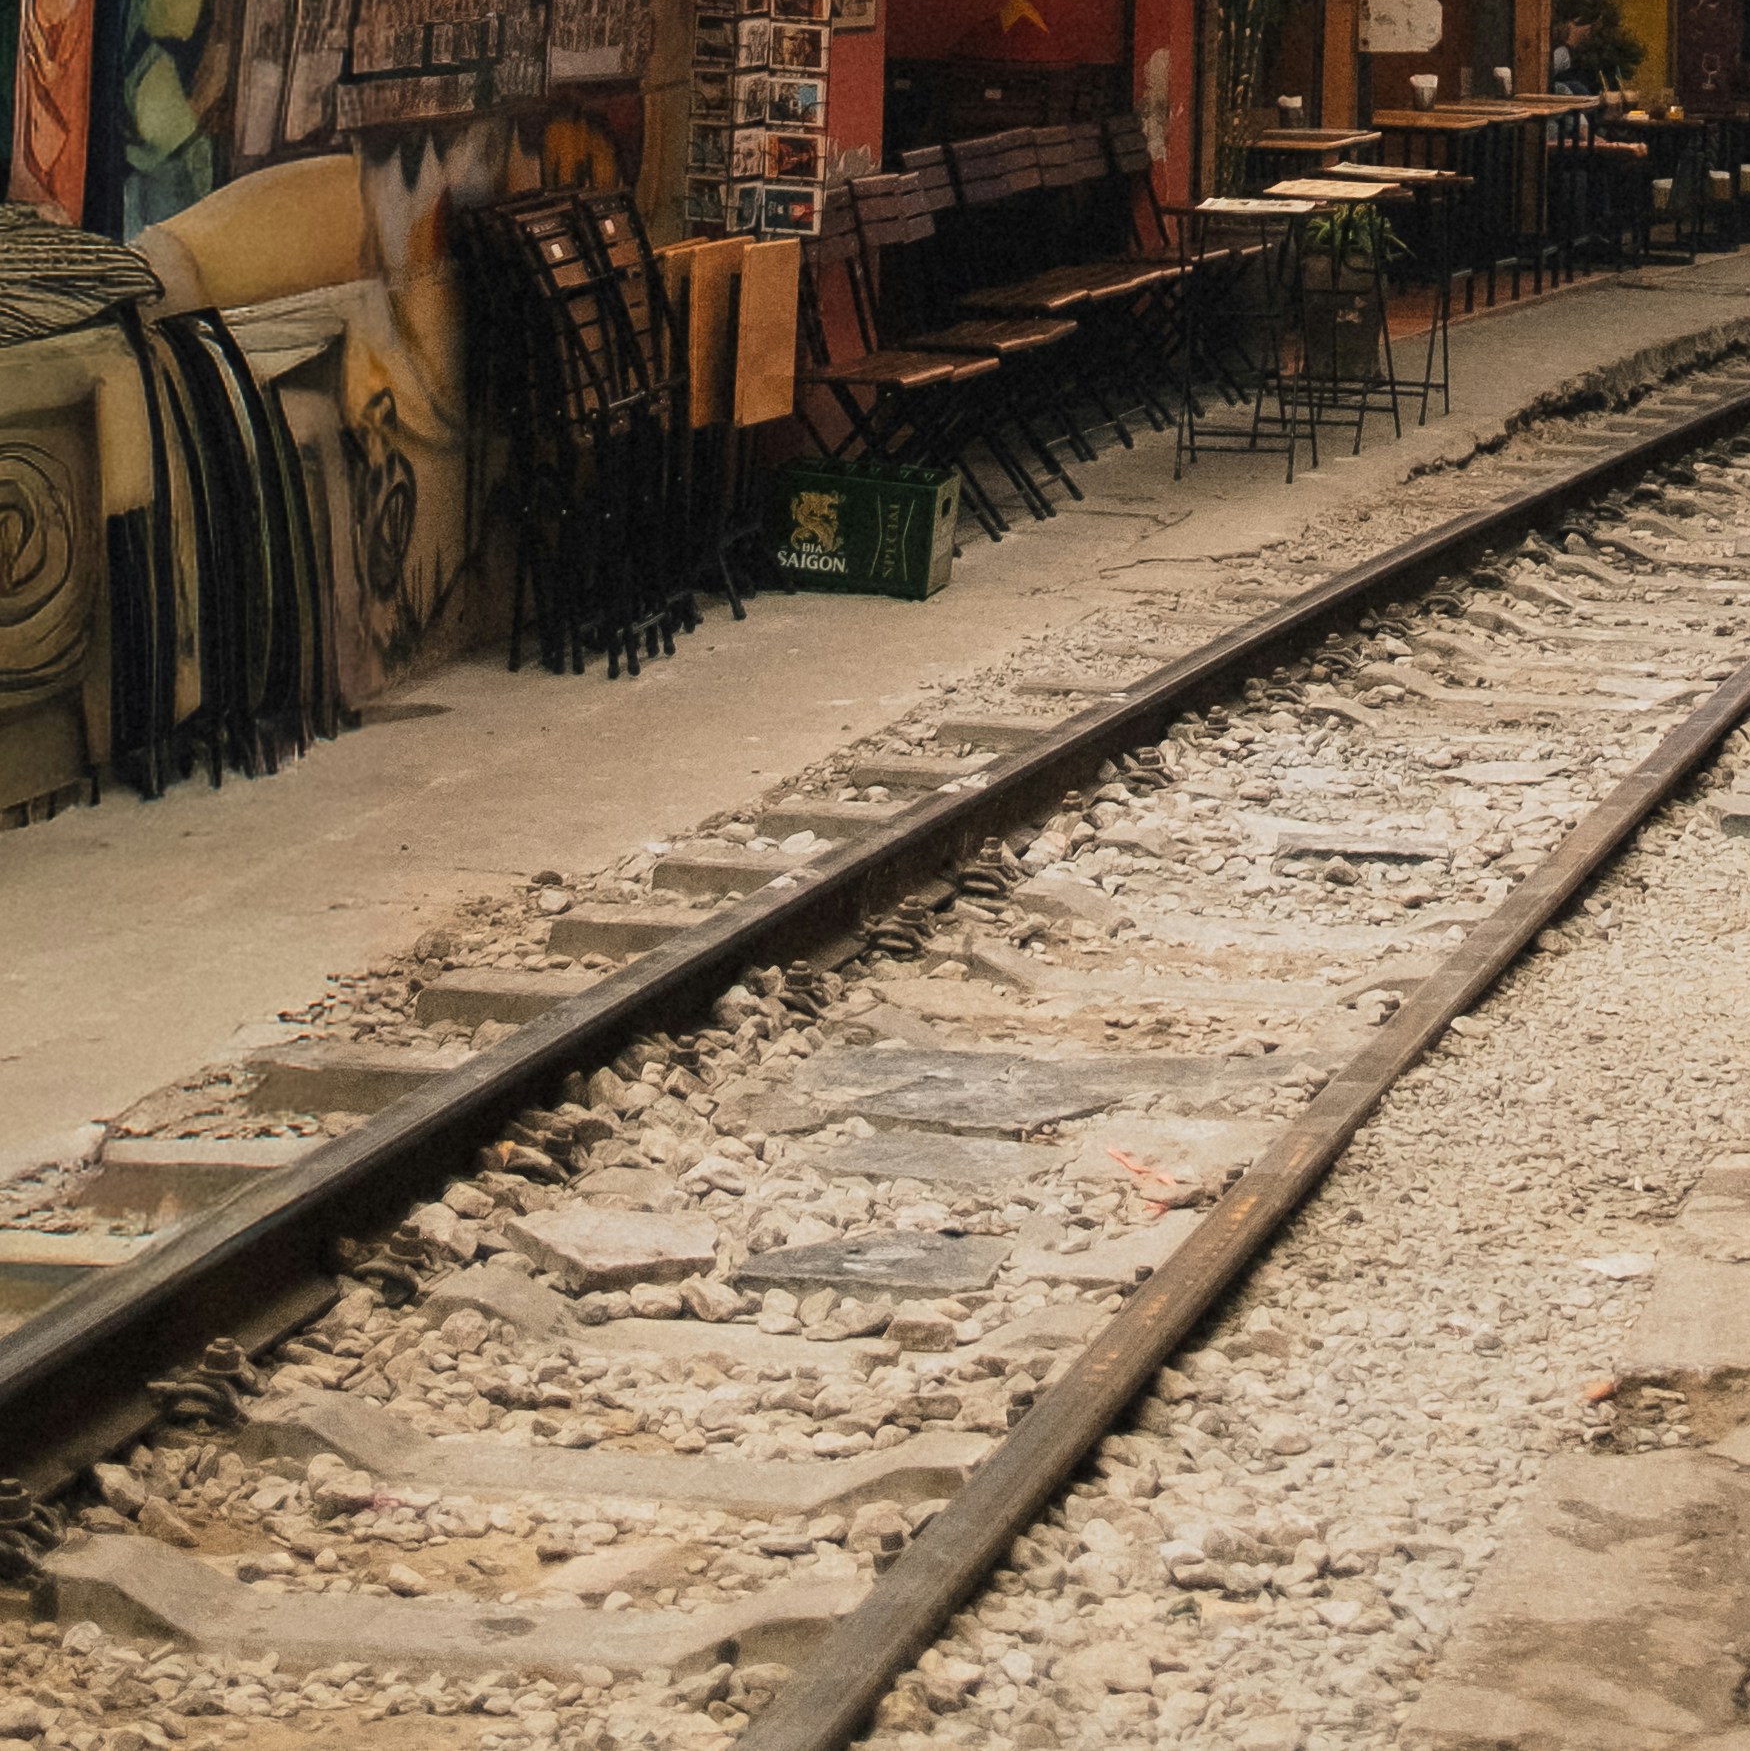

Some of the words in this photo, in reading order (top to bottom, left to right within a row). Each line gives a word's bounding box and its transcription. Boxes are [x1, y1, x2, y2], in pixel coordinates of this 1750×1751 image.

[802, 542, 823, 554] BIA
[881, 503, 901, 579] SPECIAL
[777, 550, 847, 574] SAIGON
